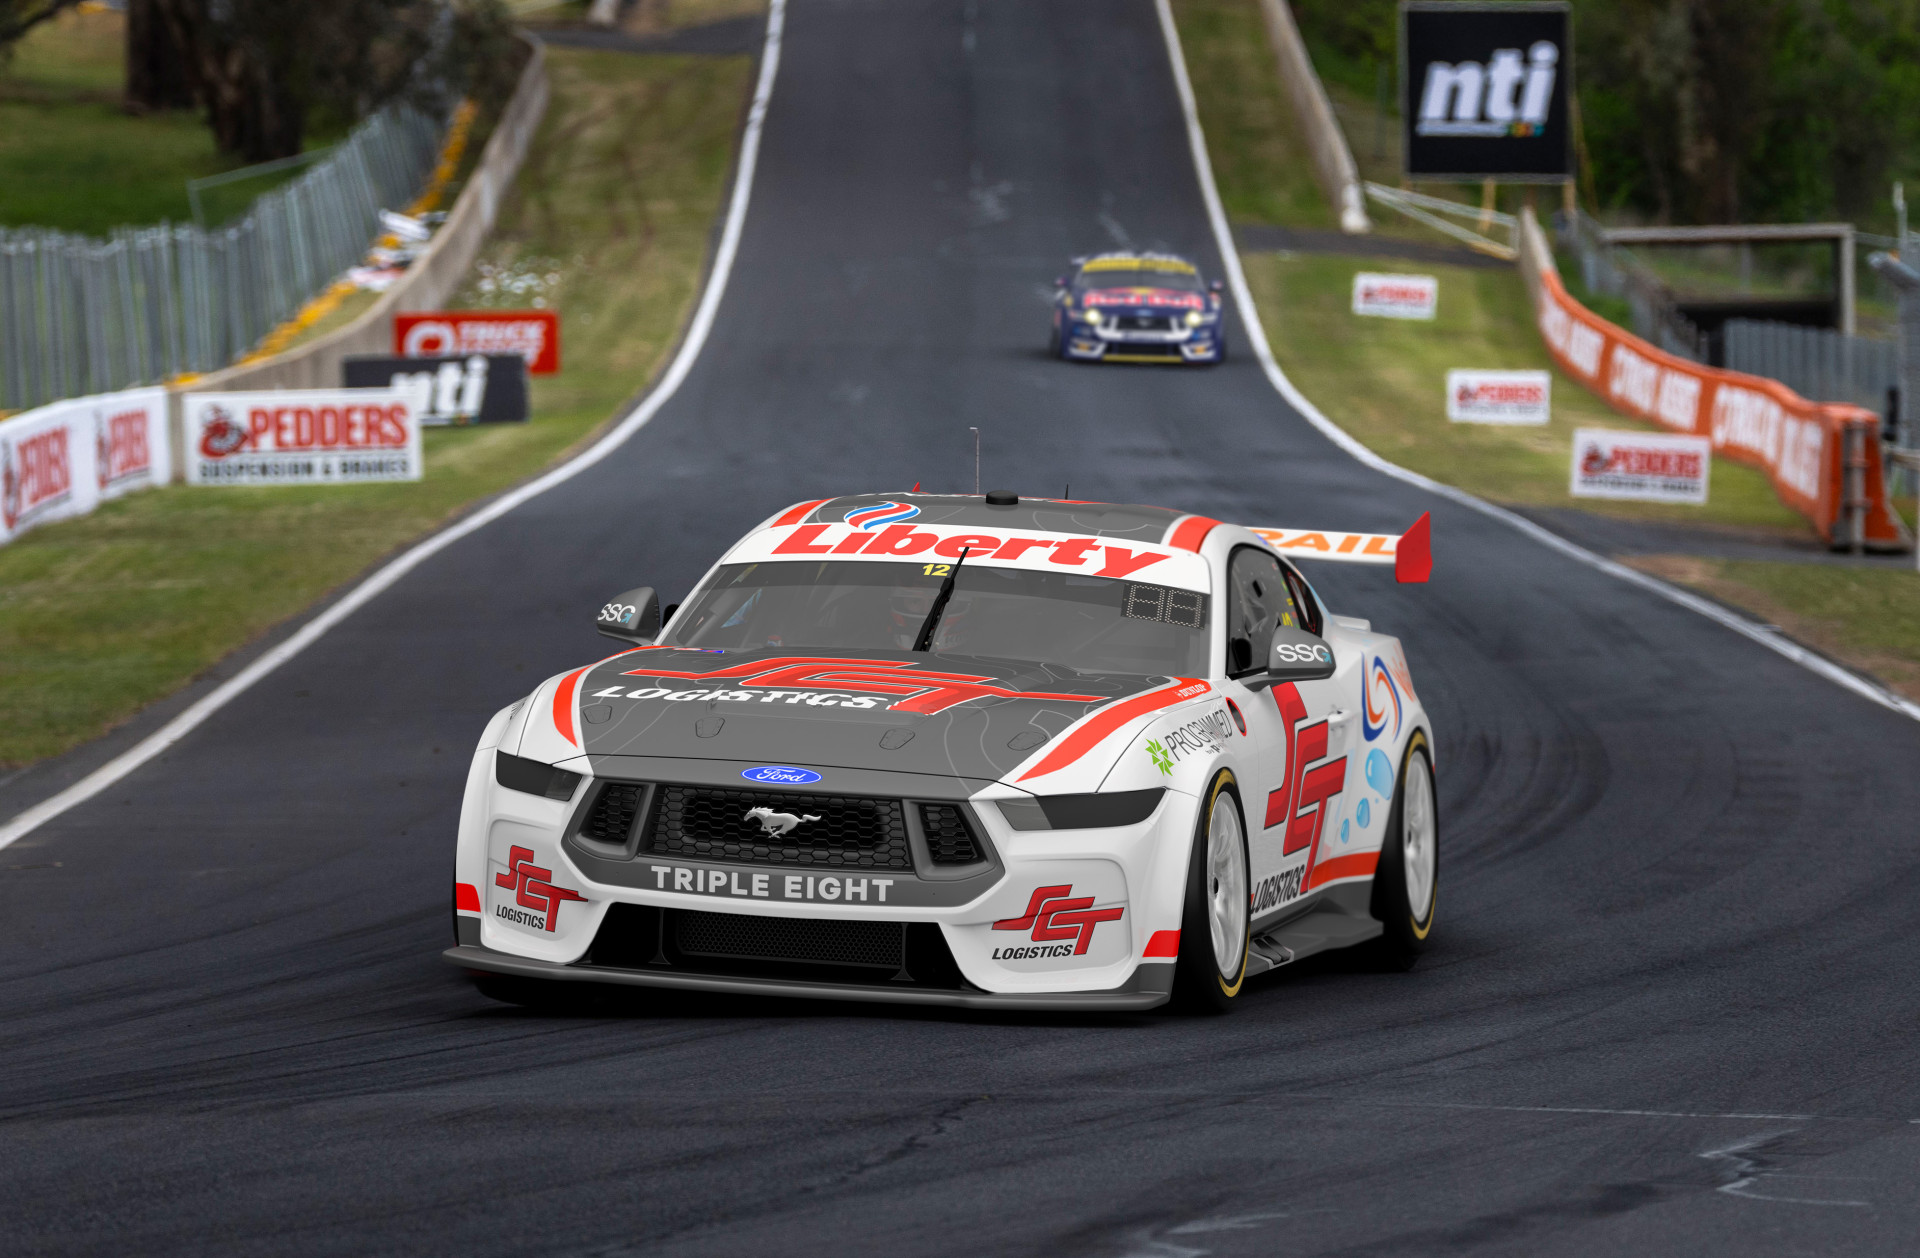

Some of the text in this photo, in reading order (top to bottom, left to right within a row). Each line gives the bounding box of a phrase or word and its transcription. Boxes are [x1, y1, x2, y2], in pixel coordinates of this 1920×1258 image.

[1418, 40, 1559, 123] nti
[249, 405, 409, 449] PEDDERS
[771, 525, 1172, 578] Liberty
[922, 563, 951, 576] 12
[591, 685, 888, 709] LOGISTICS
[755, 767, 805, 783] Ford
[495, 845, 589, 933] SCT
[651, 865, 894, 902] TRIPLE EIGHT
[1250, 863, 1306, 914] LOGISTICS
[496, 904, 546, 930] LOGISTICS
[991, 883, 1125, 956] SCT
[991, 944, 1074, 960] LOGISTICS
